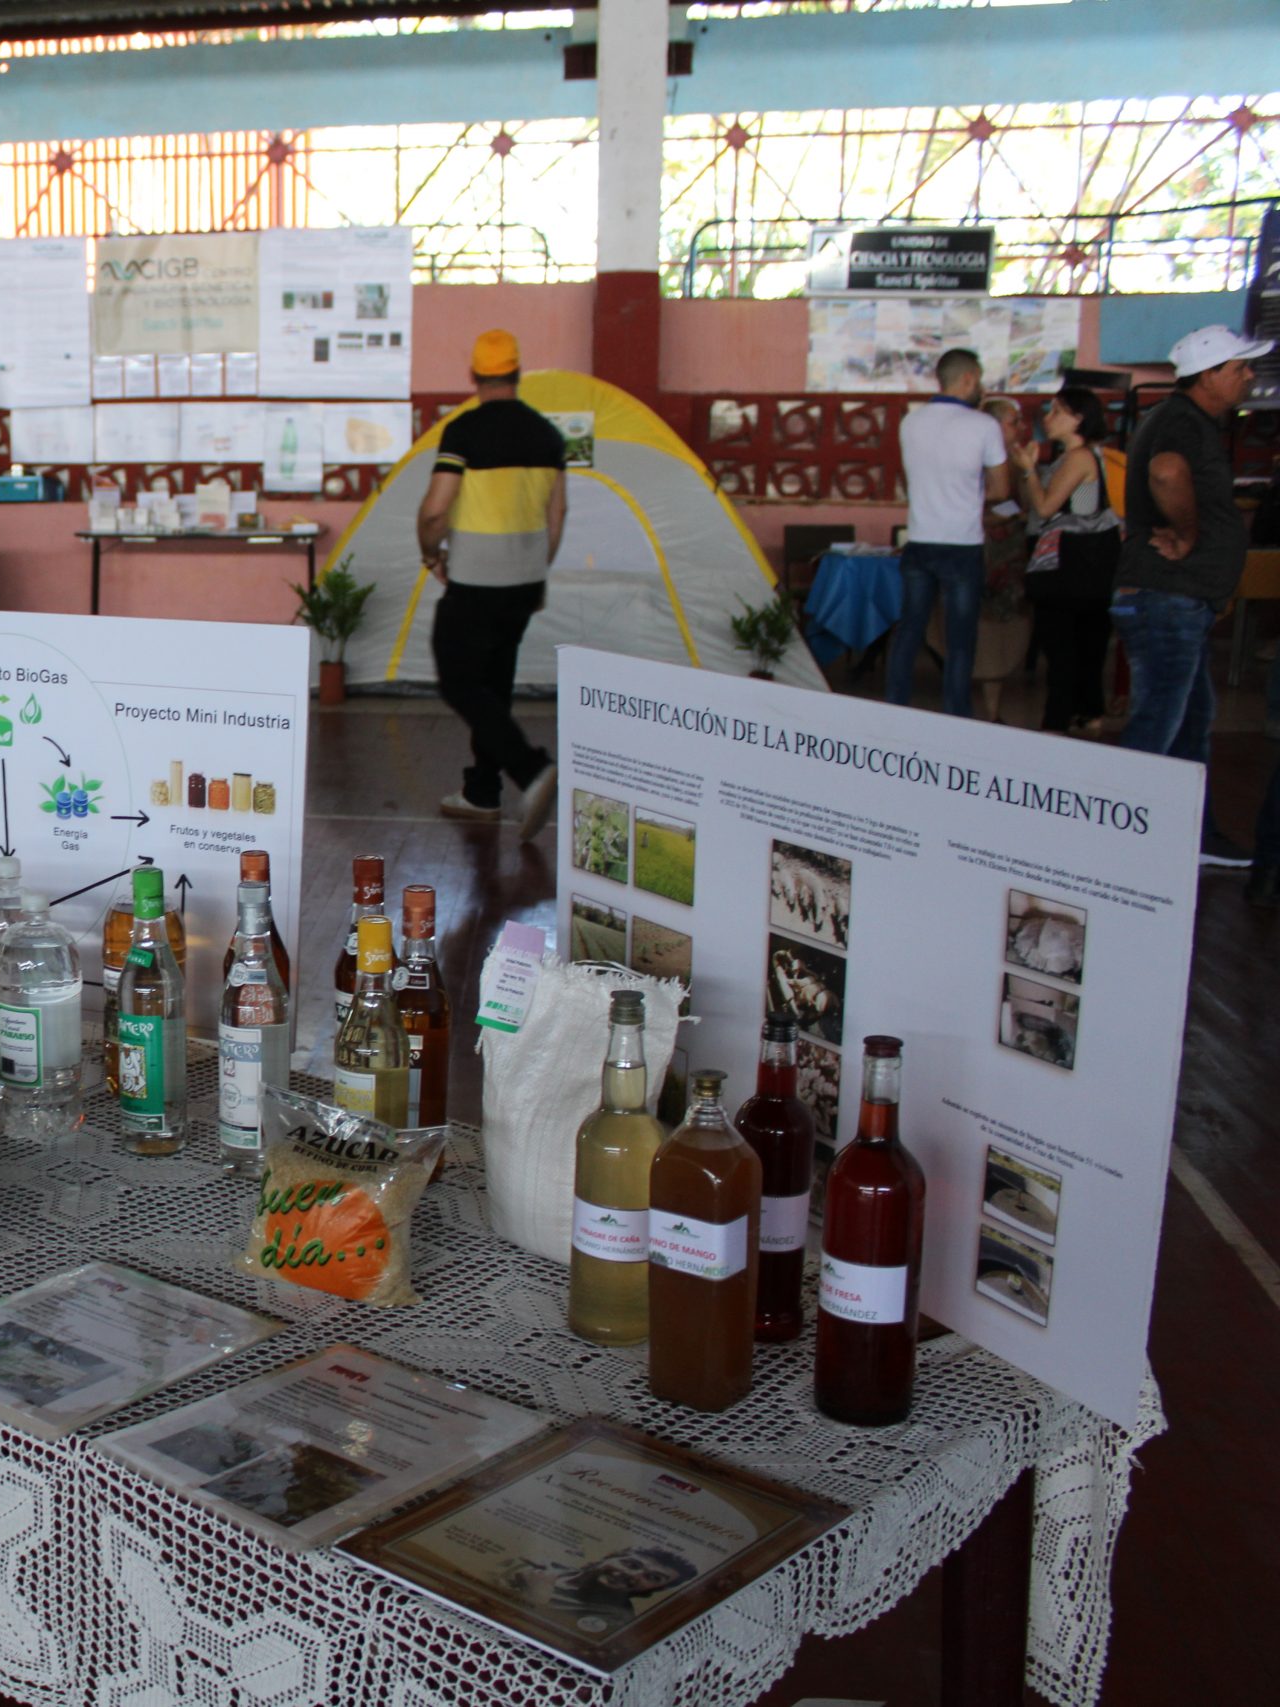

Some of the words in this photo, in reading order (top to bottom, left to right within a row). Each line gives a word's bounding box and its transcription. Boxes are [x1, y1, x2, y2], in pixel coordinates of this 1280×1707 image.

[851, 251, 898, 267] CIENCIA
[899, 252, 909, 267] Y
[141, 257, 198, 280] CIGB
[875, 274, 913, 287] Sancti
[16, 667, 69, 685] BioGas
[114, 702, 181, 722] Proyecto
[186, 707, 217, 725] Mini
[222, 710, 291, 730] Industria
[579, 685, 728, 738] DIVERSIFICACIÓN
[732, 718, 759, 746] DE
[762, 724, 791, 753] LA
[793, 731, 941, 787] PRODUCCIÓN
[946, 765, 981, 797] DE
[984, 774, 1151, 836] ALIMENTOS
[169, 824, 200, 838] Frutos
[202, 829, 210, 840] y
[211, 828, 257, 844] vegetales
[61, 840, 80, 852] Gas
[183, 841, 196, 851] en
[197, 841, 241, 855] conserva
[607, 1235, 618, 1243] DE
[620, 1233, 641, 1244] CAÑA
[669, 1242, 680, 1252] DE
[682, 1244, 718, 1262] MANGO
[834, 1288, 862, 1303] FRESA
